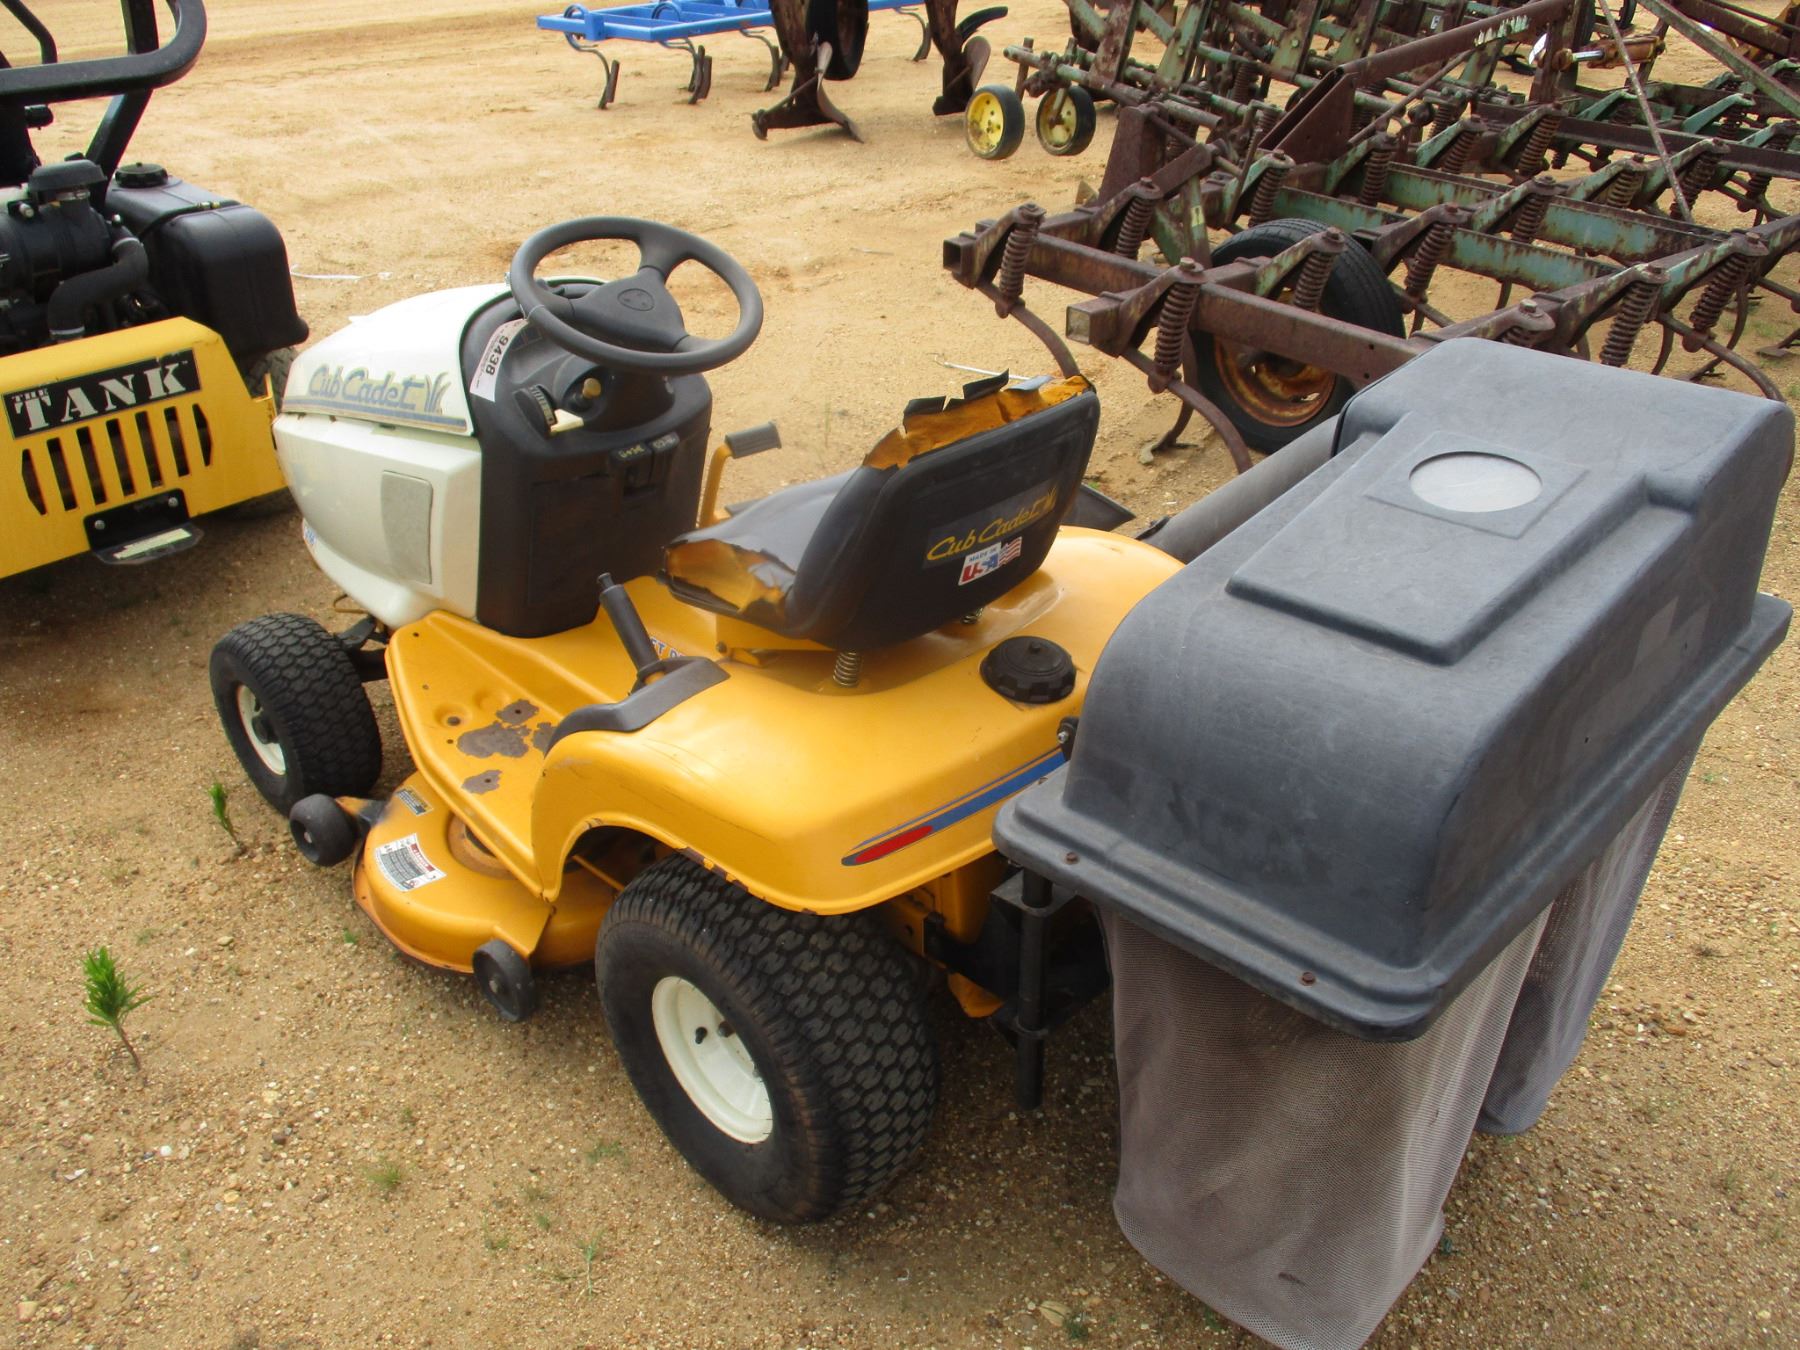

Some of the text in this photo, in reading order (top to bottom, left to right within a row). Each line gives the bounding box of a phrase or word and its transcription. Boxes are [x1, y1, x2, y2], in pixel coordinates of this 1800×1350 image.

[485, 335, 509, 376] 9438
[12, 387, 49, 404] THE
[15, 362, 186, 431] TANK
[308, 364, 425, 410] Cub Cadet
[926, 497, 1045, 561] Cub Cadet
